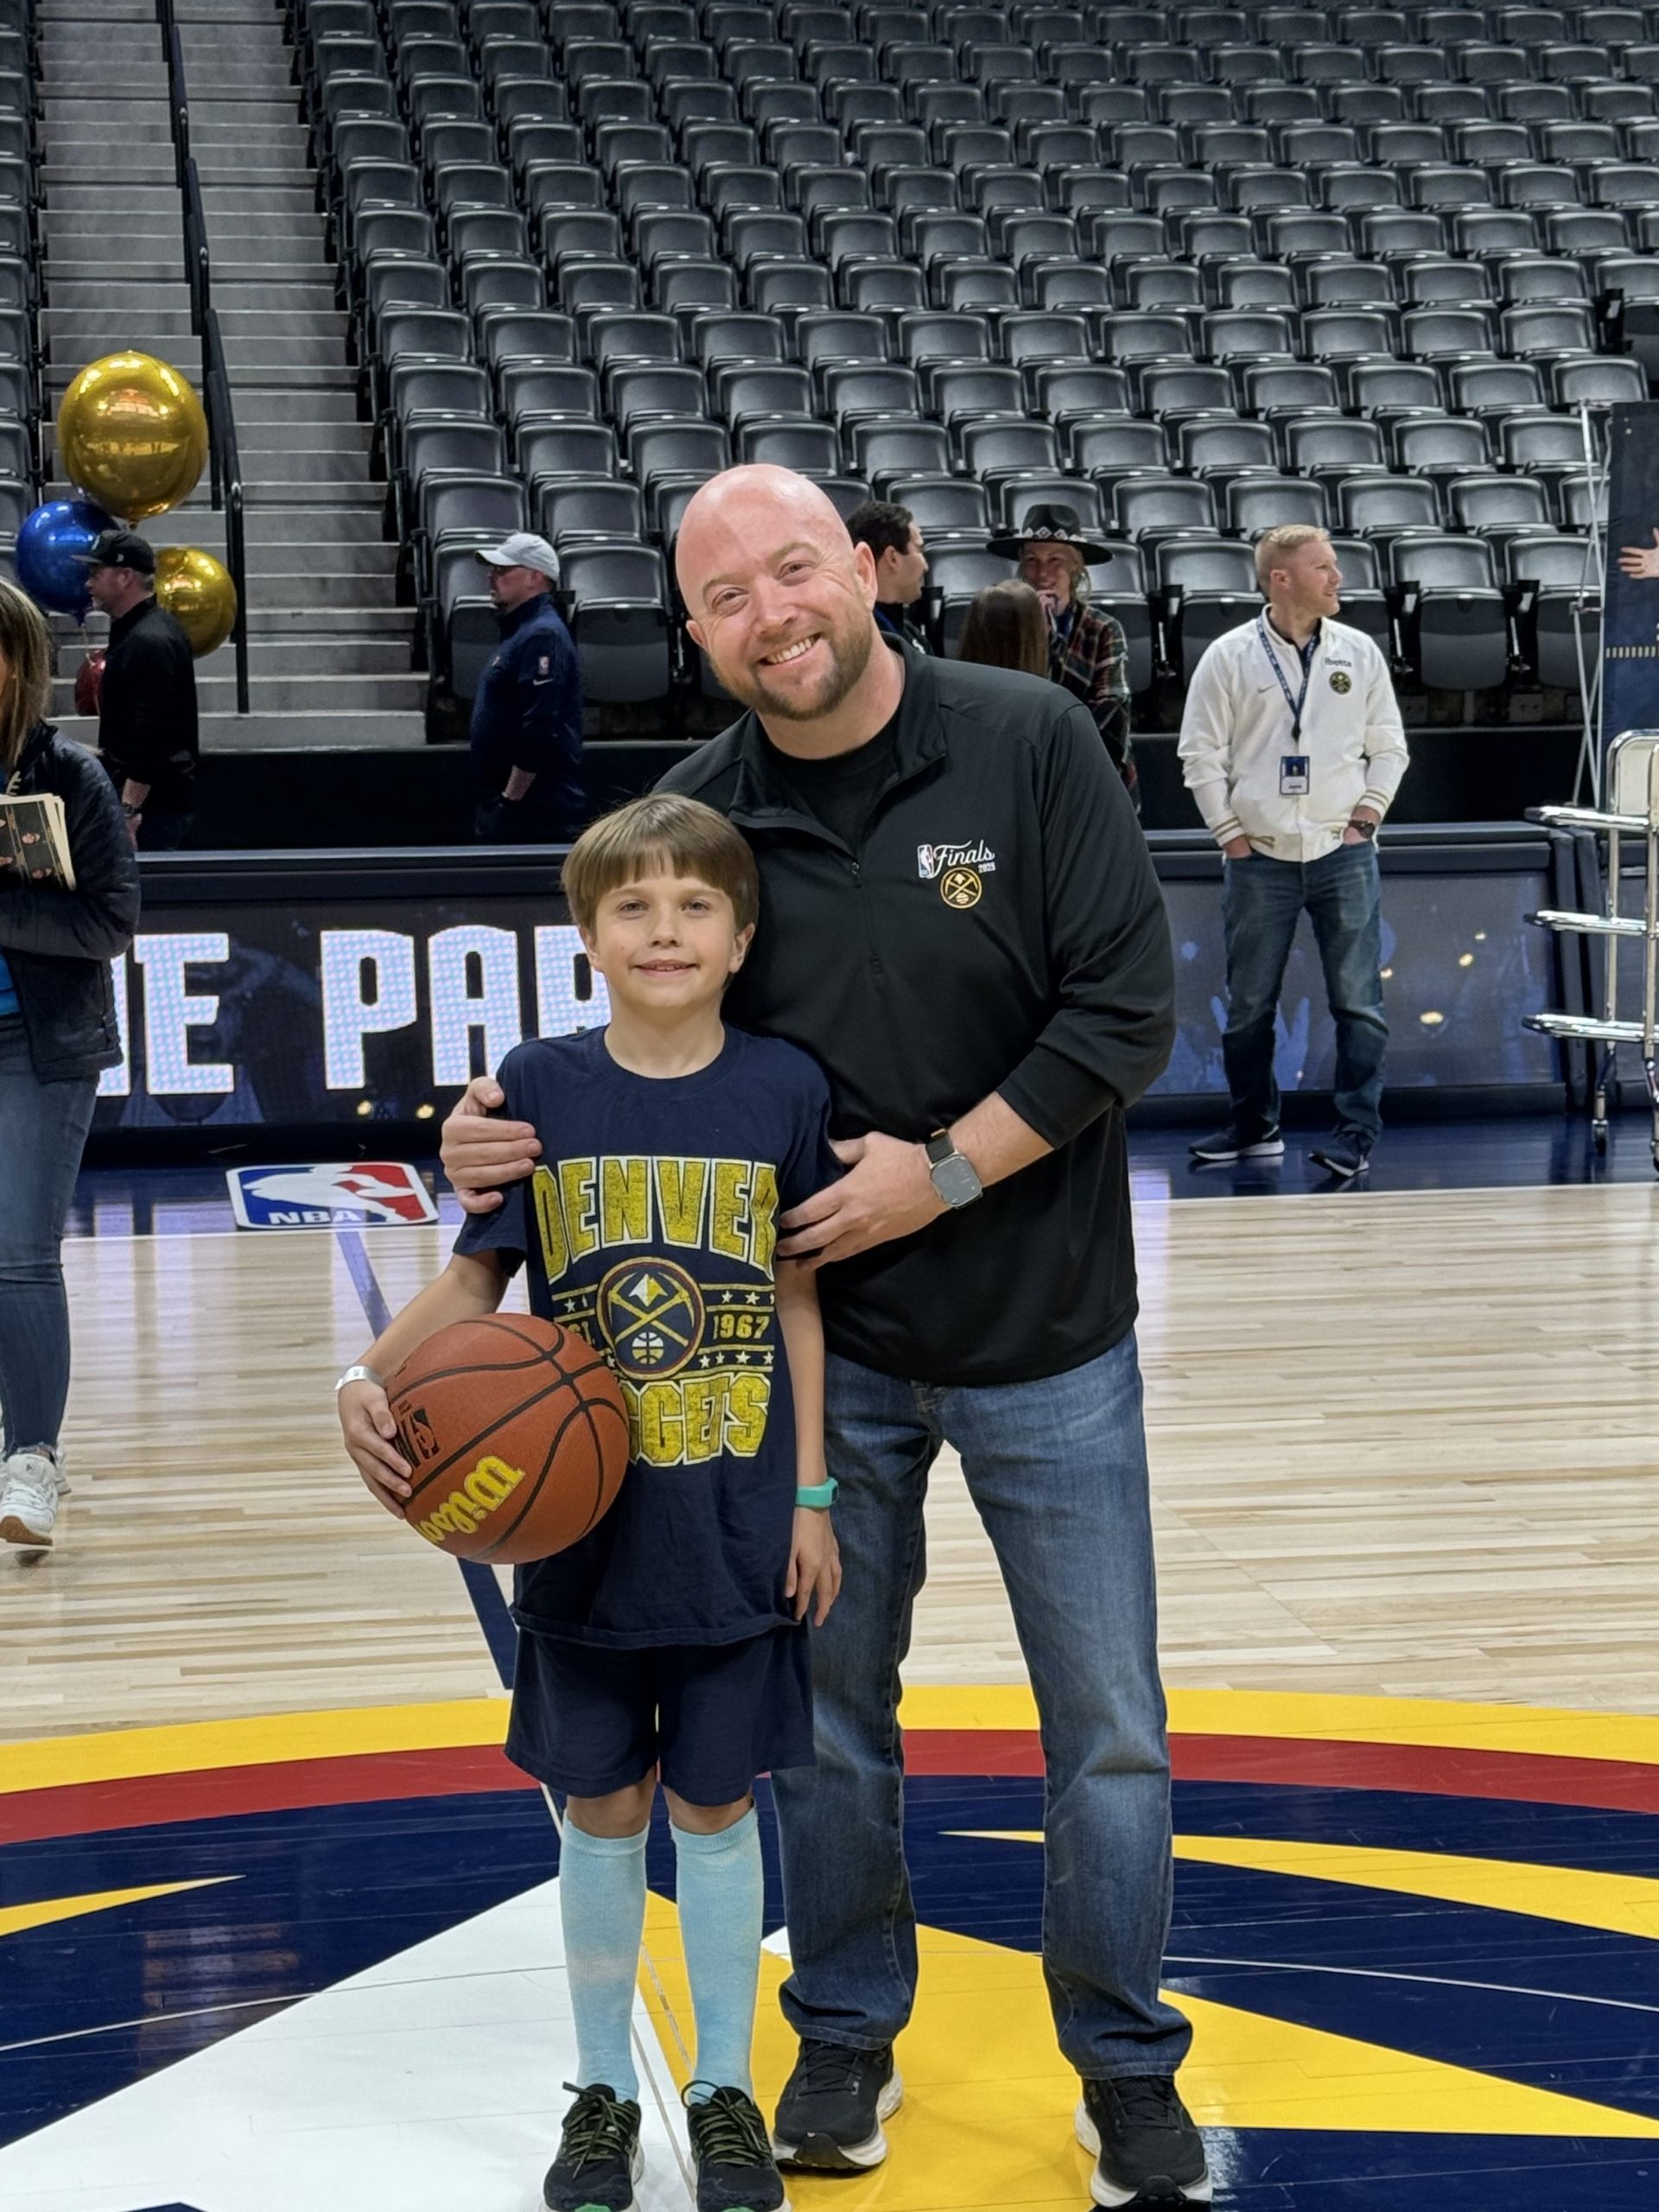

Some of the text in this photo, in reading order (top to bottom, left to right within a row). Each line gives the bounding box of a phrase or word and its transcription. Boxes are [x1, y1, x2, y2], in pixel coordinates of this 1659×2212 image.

[933, 839, 995, 879] Finals
[268, 1210, 362, 1224] NBA
[531, 1155, 779, 1285] DENVER
[713, 1314, 771, 1340] 1967
